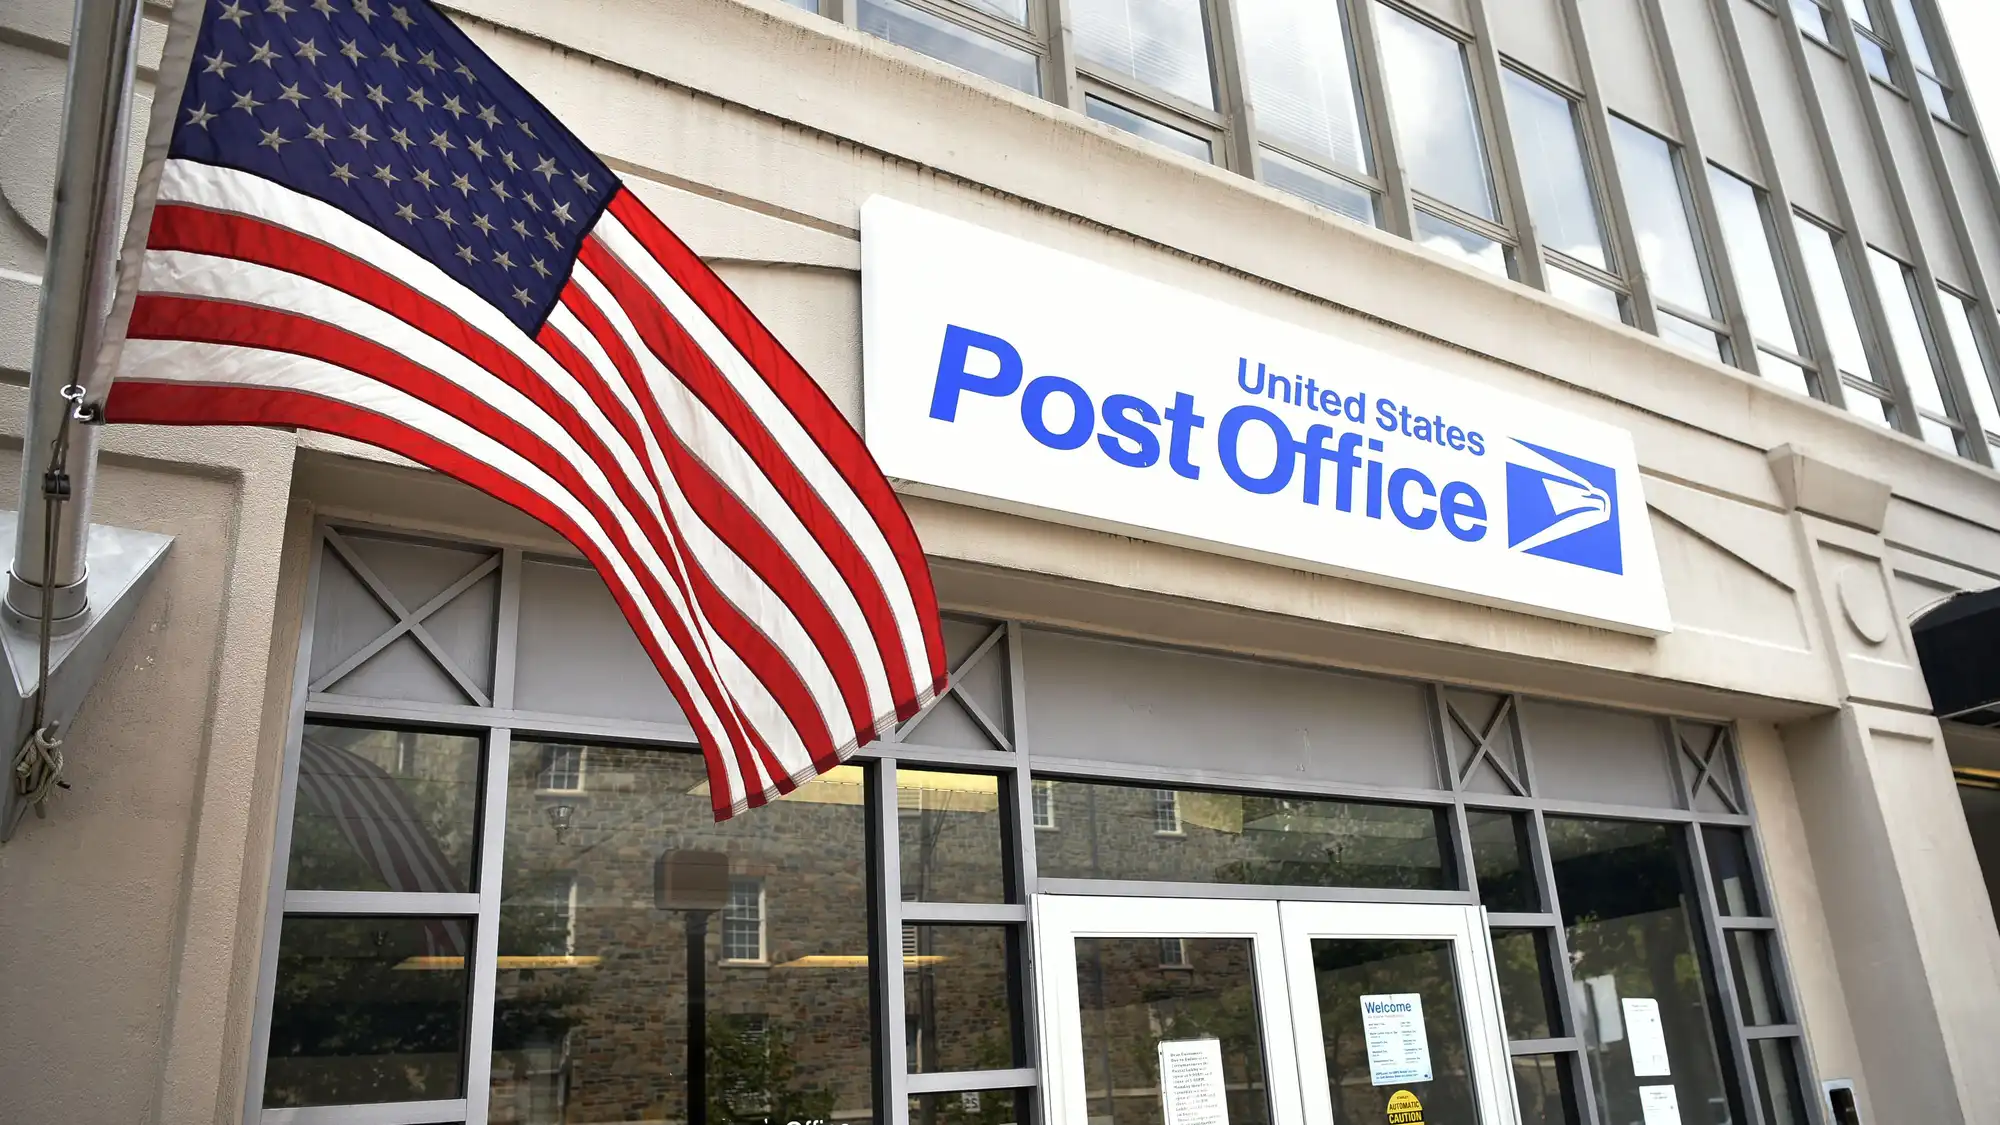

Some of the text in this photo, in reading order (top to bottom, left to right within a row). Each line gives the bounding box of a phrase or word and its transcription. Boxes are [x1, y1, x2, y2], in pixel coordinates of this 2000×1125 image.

[1239, 358, 1485, 457] United States
[930, 324, 1487, 543] Post Office
[1364, 1001, 1412, 1014] Welcome
[1389, 1101, 1419, 1110] AUTOMATIC
[1389, 1111, 1422, 1124] CAUTION
